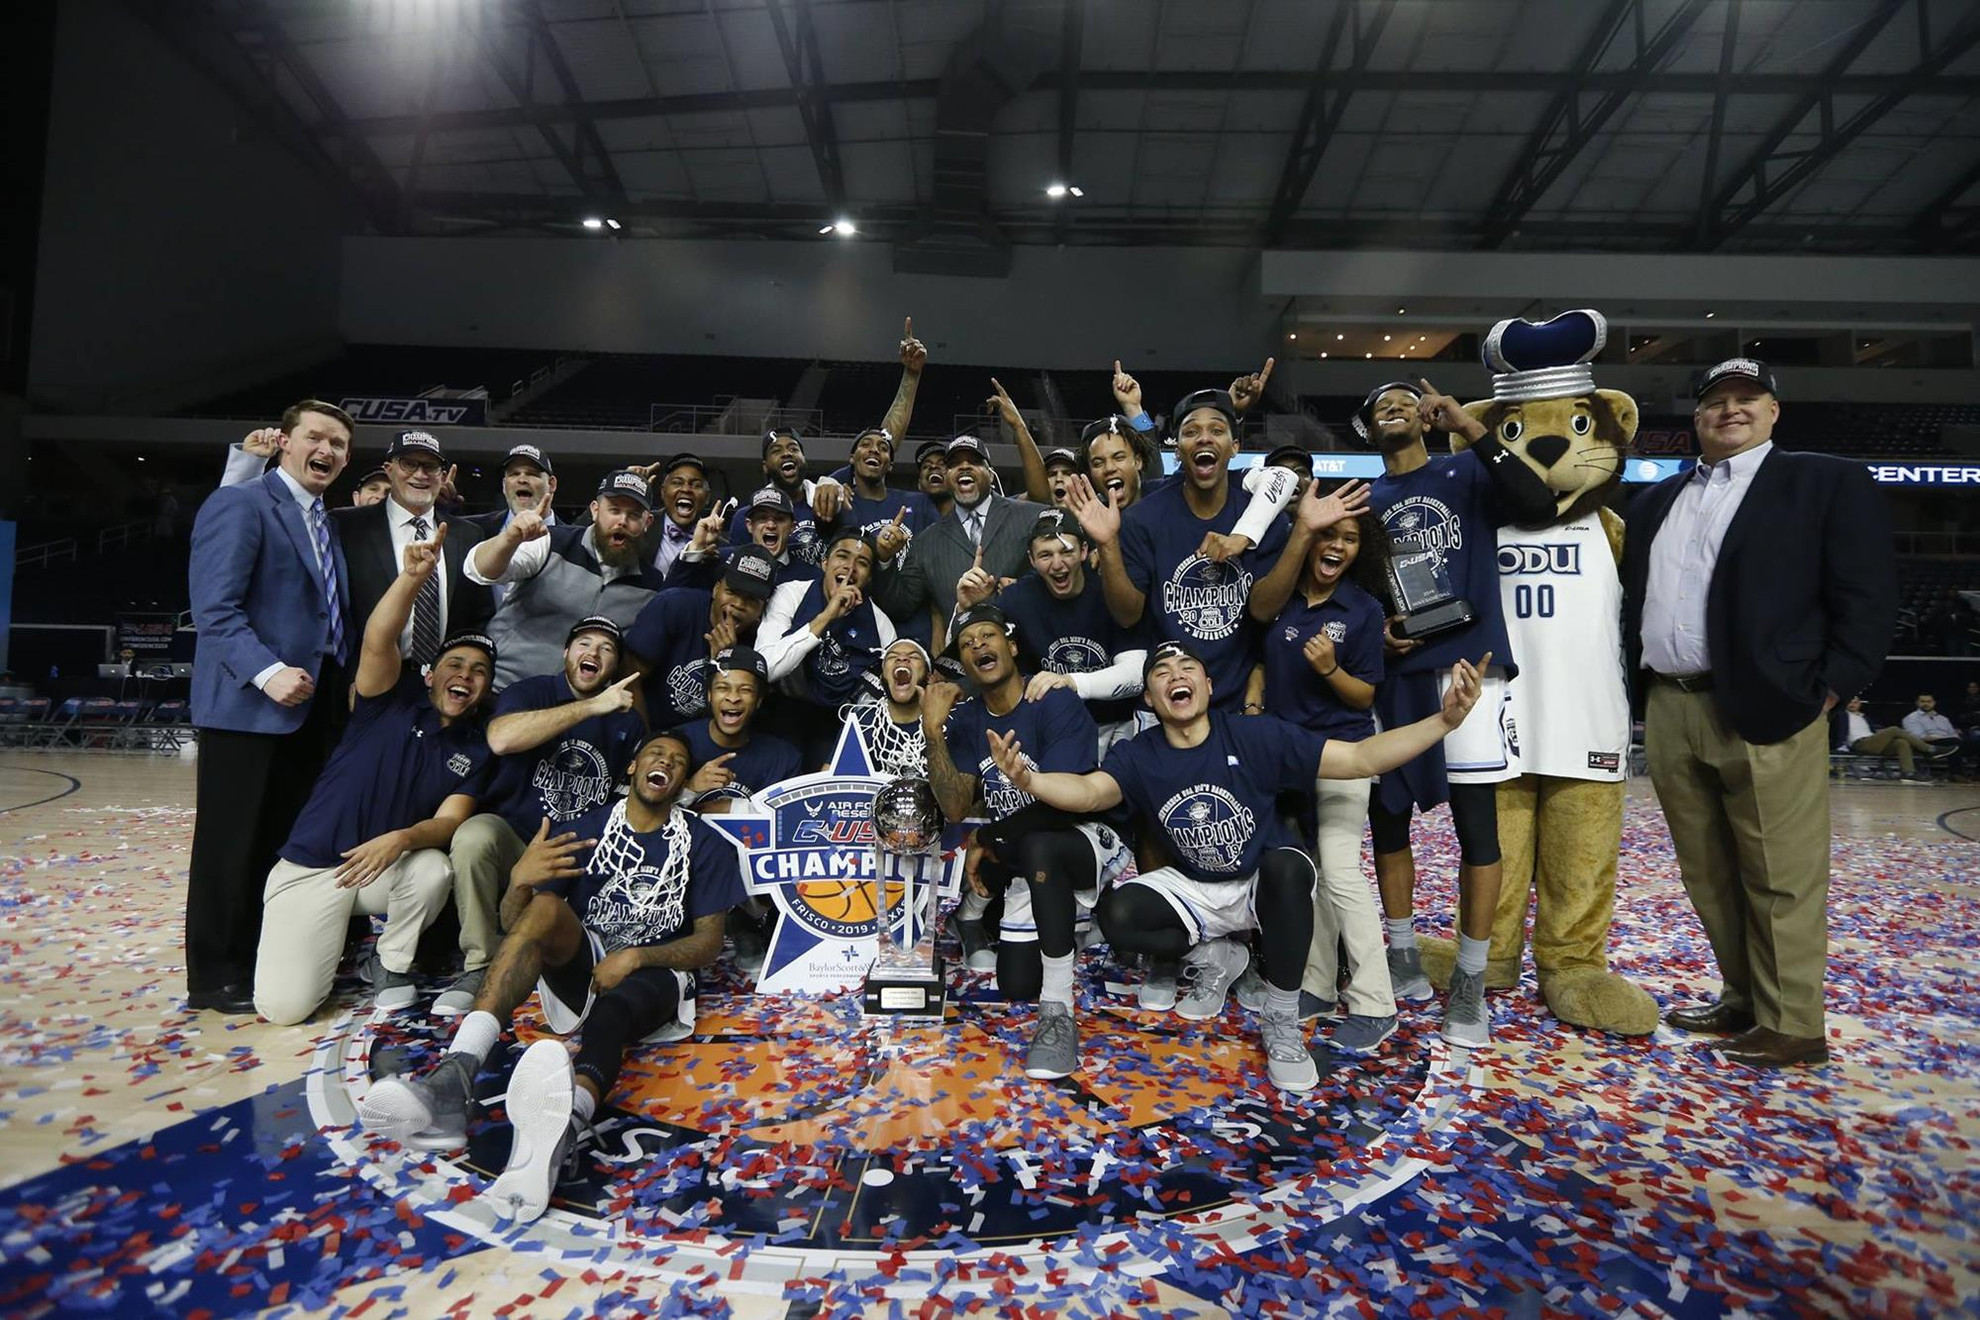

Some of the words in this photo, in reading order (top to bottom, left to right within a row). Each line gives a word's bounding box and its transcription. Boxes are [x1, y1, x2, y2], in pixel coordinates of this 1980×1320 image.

[1313, 460, 1346, 472] AT&T
[1497, 543, 1582, 575] ODU
[1515, 584, 1554, 618] 00
[532, 758, 612, 806] CHAPIONS
[827, 801, 852, 810] AIR
[831, 809, 869, 818] RESE
[1170, 806, 1256, 850] AMPIONS
[791, 898, 829, 931] FRISCO
[838, 923, 869, 935] 2019
